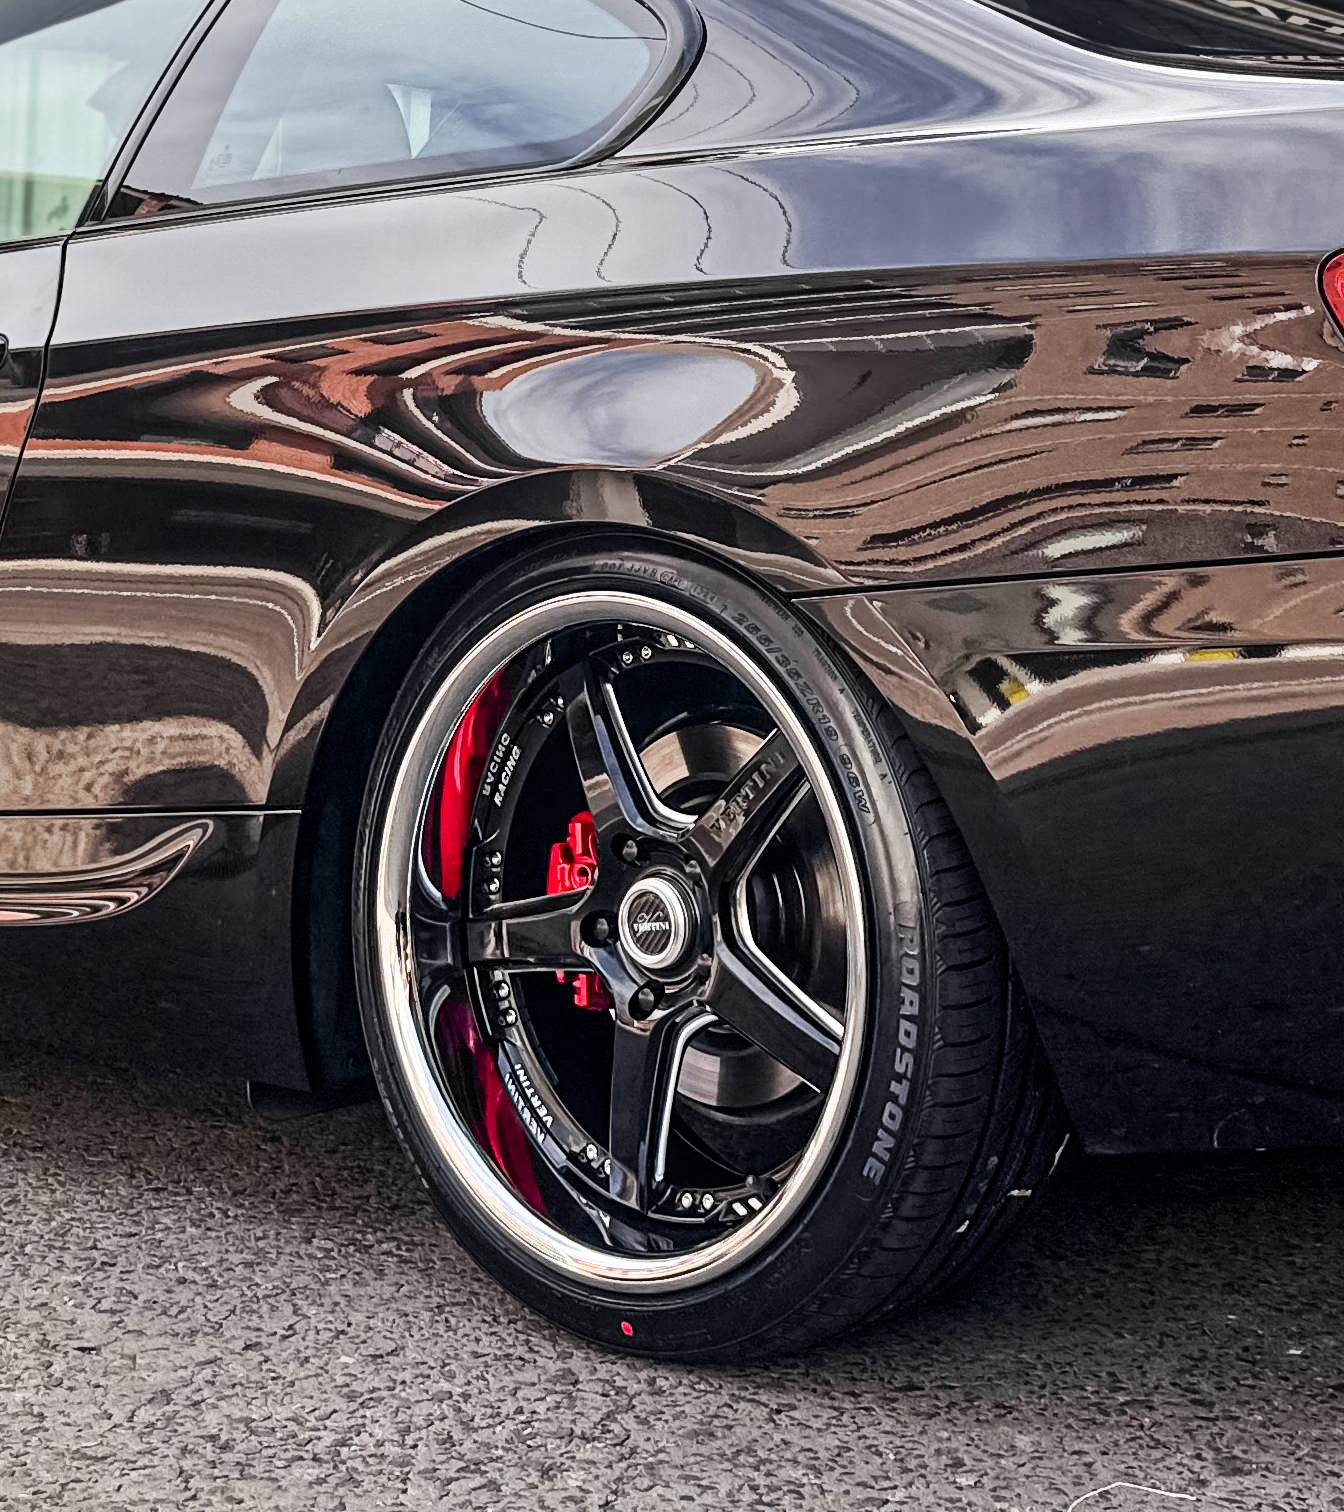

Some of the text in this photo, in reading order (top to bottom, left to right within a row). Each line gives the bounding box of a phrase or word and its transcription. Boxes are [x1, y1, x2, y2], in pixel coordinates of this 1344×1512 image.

[493, 744, 521, 808] RACING
[708, 750, 786, 835] VERTINI
[862, 924, 920, 1186] ROADSTONE
[514, 1063, 554, 1129] VERTINI
